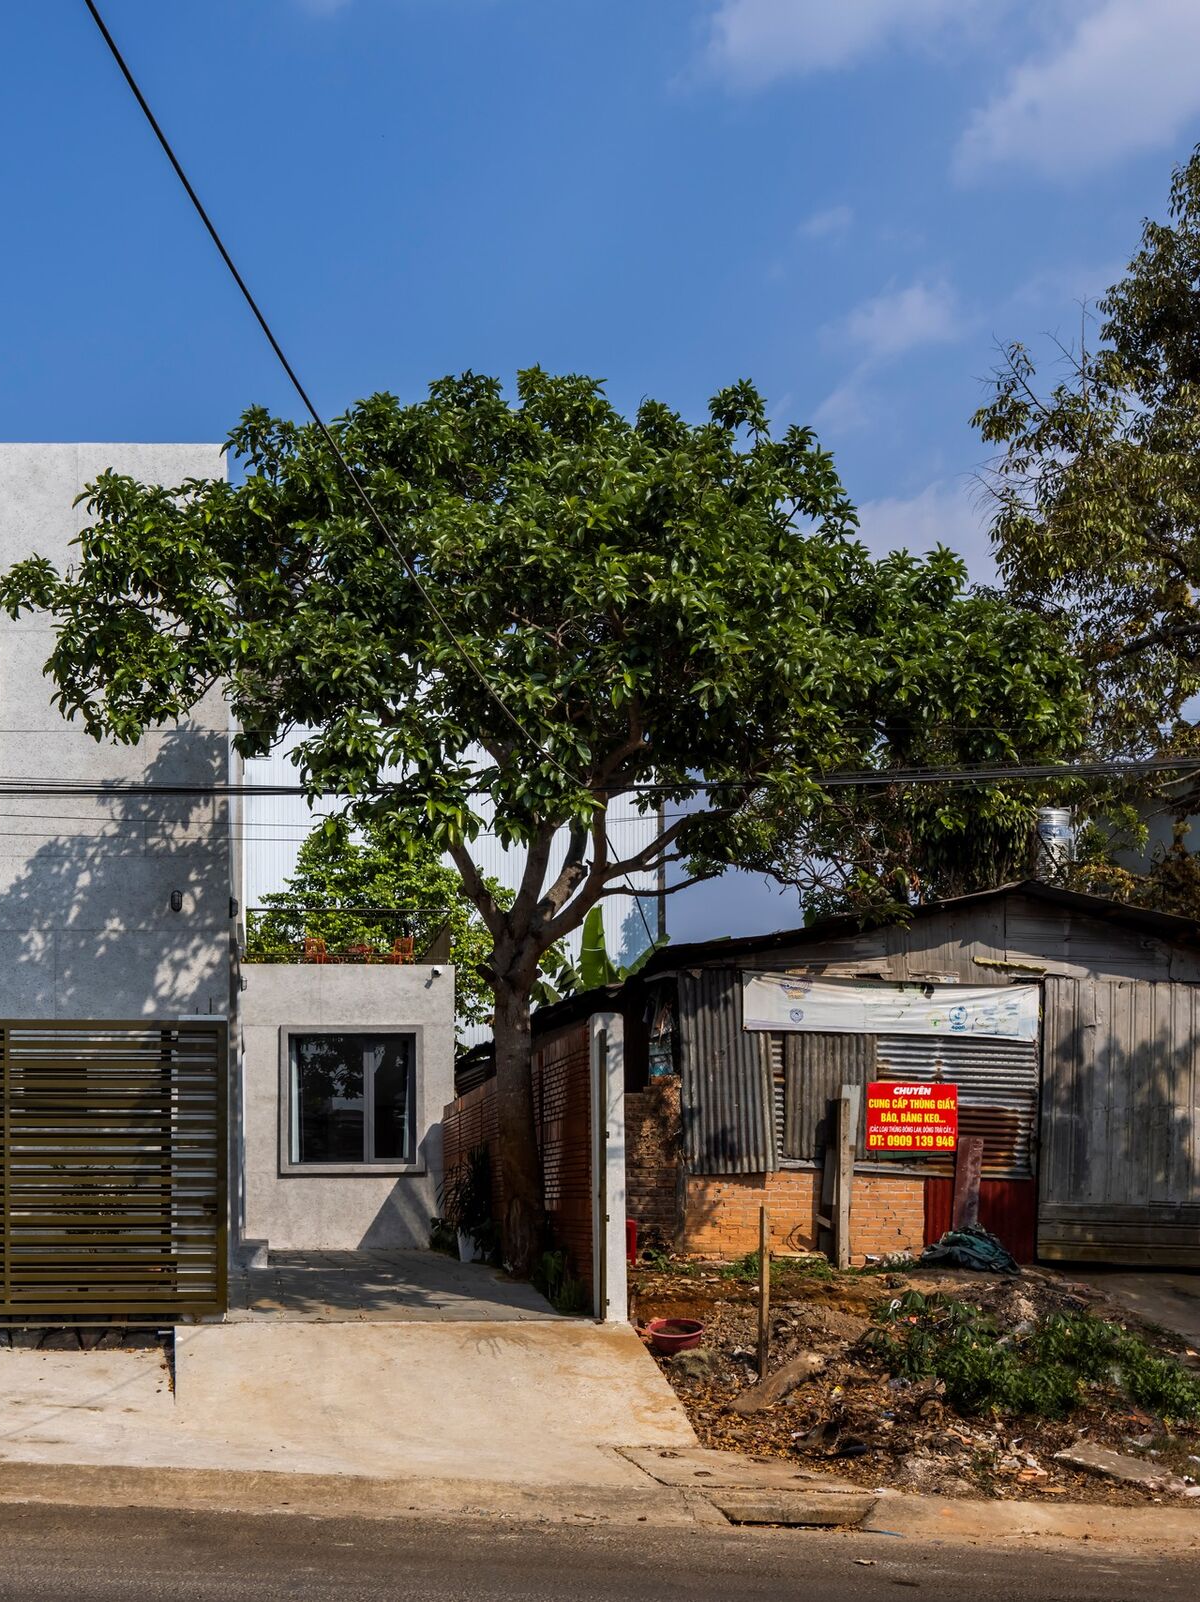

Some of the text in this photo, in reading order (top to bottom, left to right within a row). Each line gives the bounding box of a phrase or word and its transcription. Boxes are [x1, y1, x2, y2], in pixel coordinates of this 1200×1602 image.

[893, 1085, 932, 1095] CHUYÊN
[868, 1096, 956, 1110] CUNG CẤP THÙNG GIẤY,
[880, 1111, 899, 1123] BÁO,
[900, 1111, 922, 1123] BĂNG
[869, 1135, 954, 1147] ĐT: 0909 139 946
